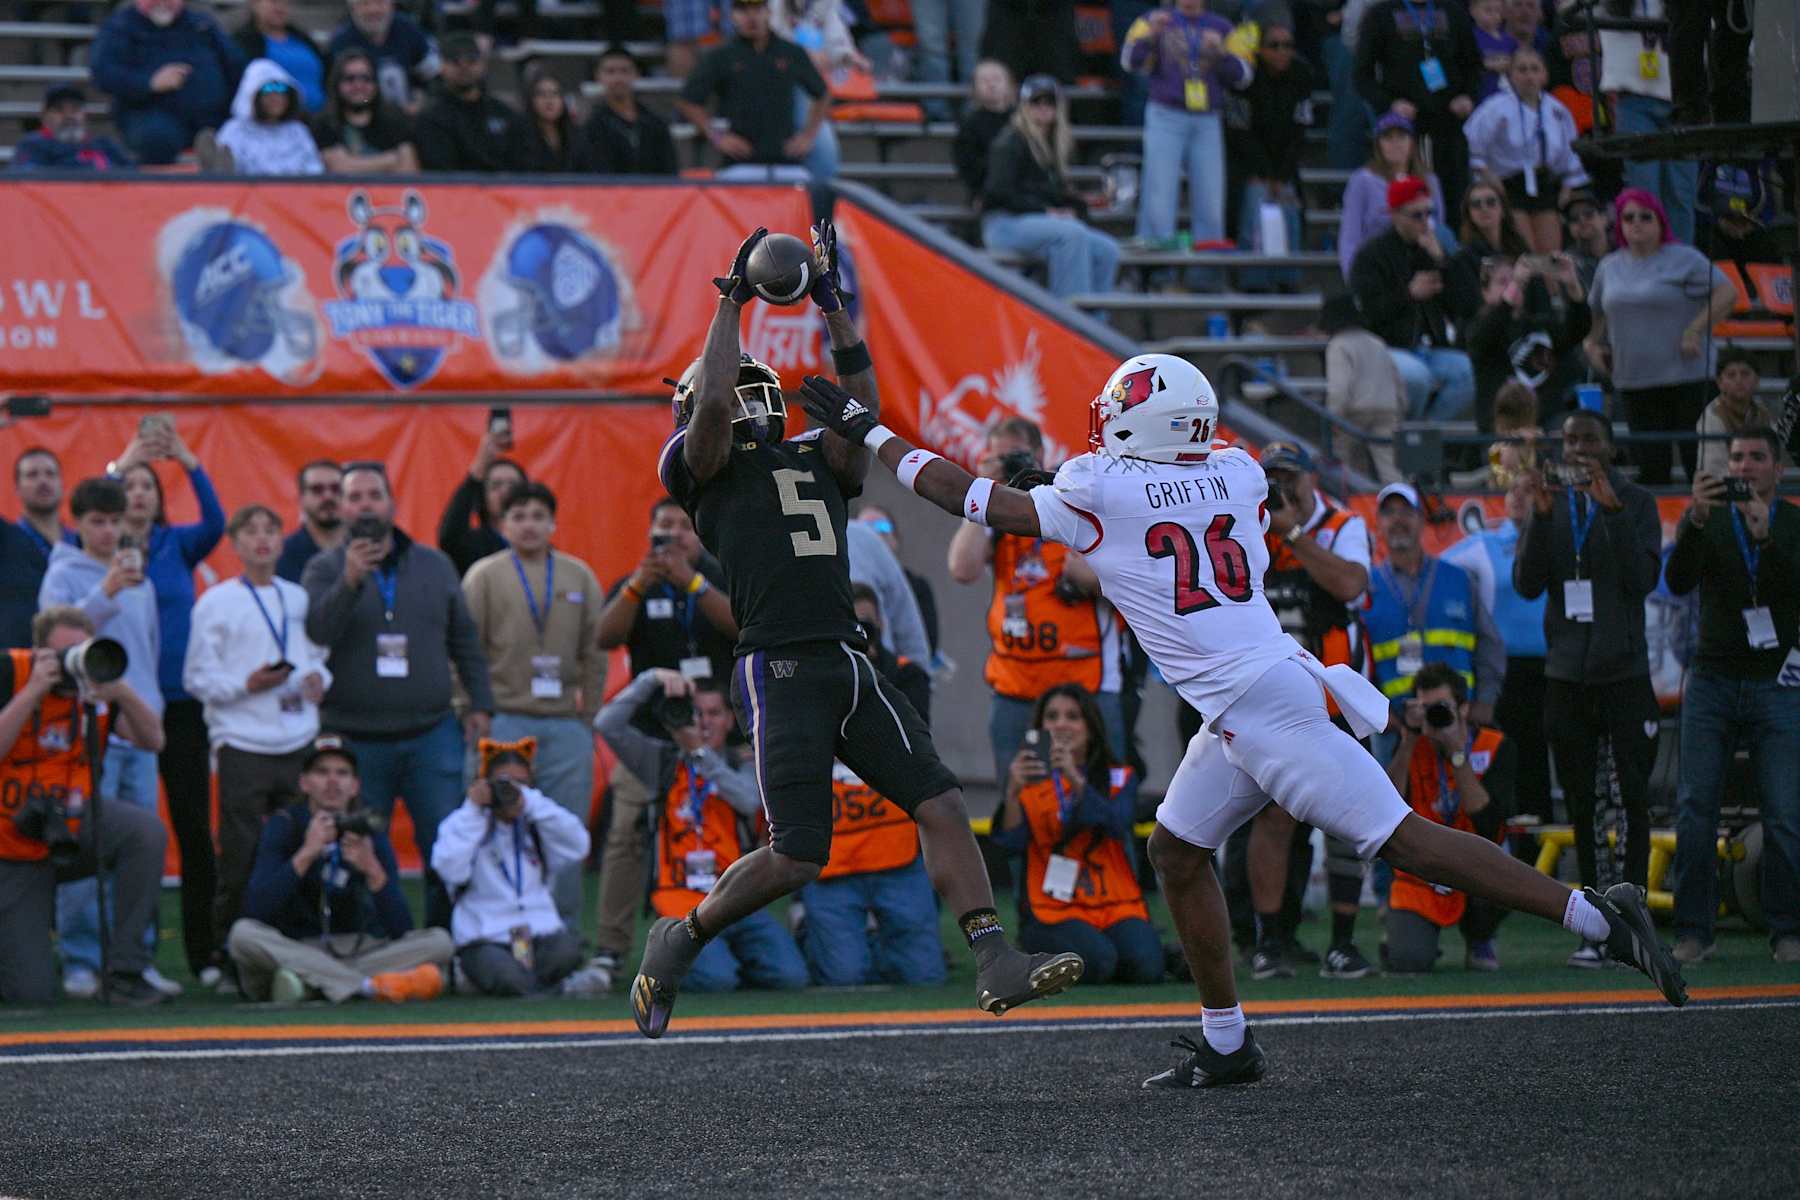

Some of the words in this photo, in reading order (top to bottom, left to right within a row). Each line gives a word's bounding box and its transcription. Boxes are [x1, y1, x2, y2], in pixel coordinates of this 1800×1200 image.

[0, 280, 106, 319] WL
[842, 406, 869, 421] adidas
[1189, 417, 1210, 443] 26
[1145, 476, 1230, 509] GRIFFIN
[772, 468, 837, 557] 5
[1145, 513, 1253, 616] 26
[769, 660, 798, 679] W
